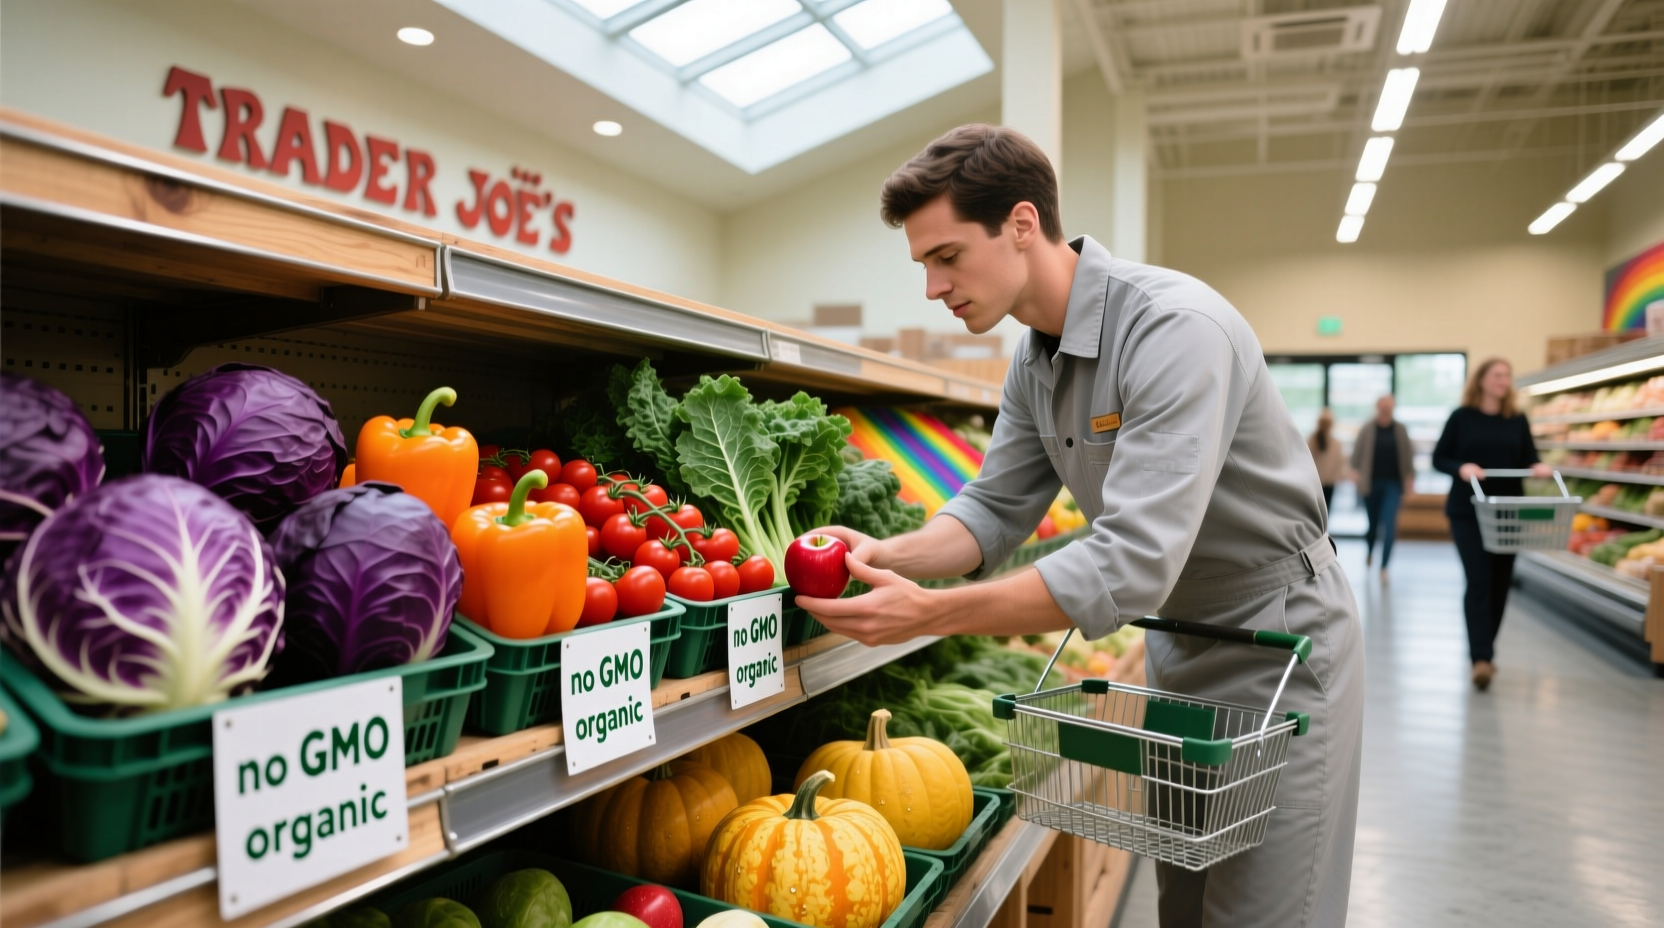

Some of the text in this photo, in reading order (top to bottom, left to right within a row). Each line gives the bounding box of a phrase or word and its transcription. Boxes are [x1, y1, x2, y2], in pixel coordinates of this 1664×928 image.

[163, 66, 438, 217] TRADER
[734, 628, 747, 648] no
[571, 649, 643, 695] no GMO
[576, 695, 643, 743] organic
[239, 716, 389, 794] no GMO
[246, 784, 387, 859] organic
